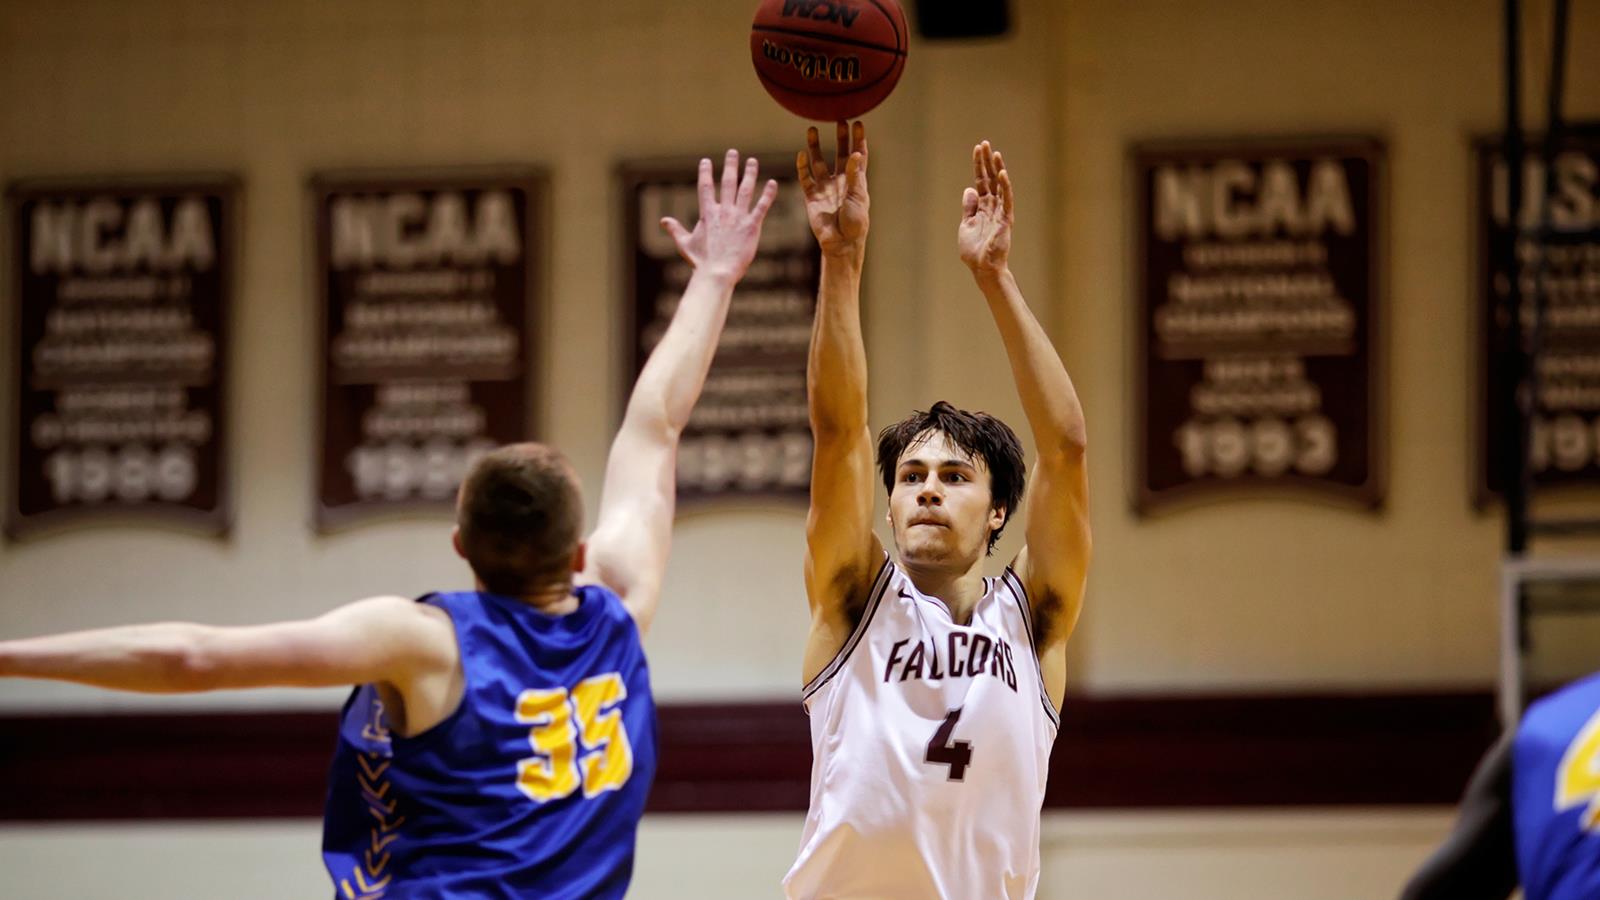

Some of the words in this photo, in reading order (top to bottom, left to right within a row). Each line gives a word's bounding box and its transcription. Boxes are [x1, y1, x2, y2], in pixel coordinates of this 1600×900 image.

[762, 39, 861, 82] Wilson
[30, 200, 215, 274] NCAA
[330, 194, 519, 270] NCAA
[1155, 160, 1355, 240] NCAA
[1174, 418, 1338, 477] 1993
[884, 631, 1019, 693] FALCONS
[514, 671, 633, 803] 35
[923, 706, 974, 783] 4
